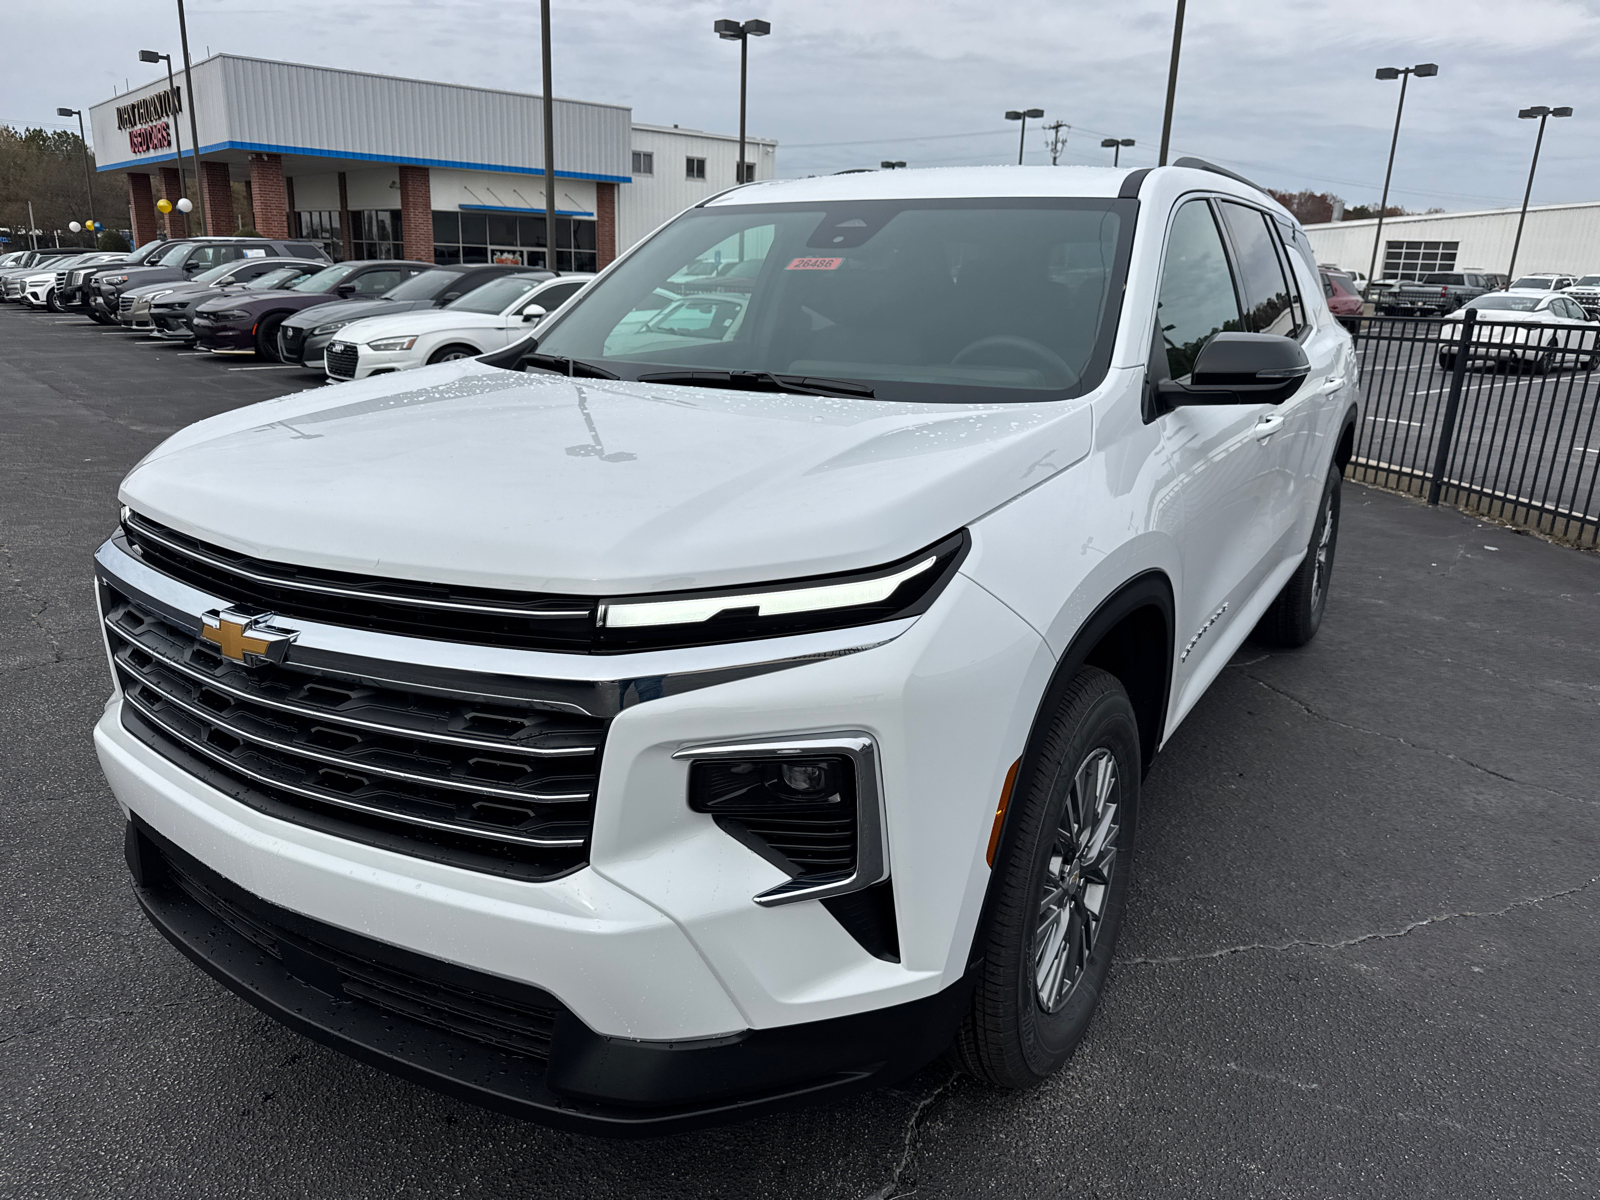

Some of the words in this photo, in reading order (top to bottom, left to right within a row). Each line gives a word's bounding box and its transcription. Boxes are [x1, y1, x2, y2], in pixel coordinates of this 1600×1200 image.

[129, 128, 148, 153] USED
[147, 121, 170, 150] CARS
[794, 259, 834, 268] 26486
